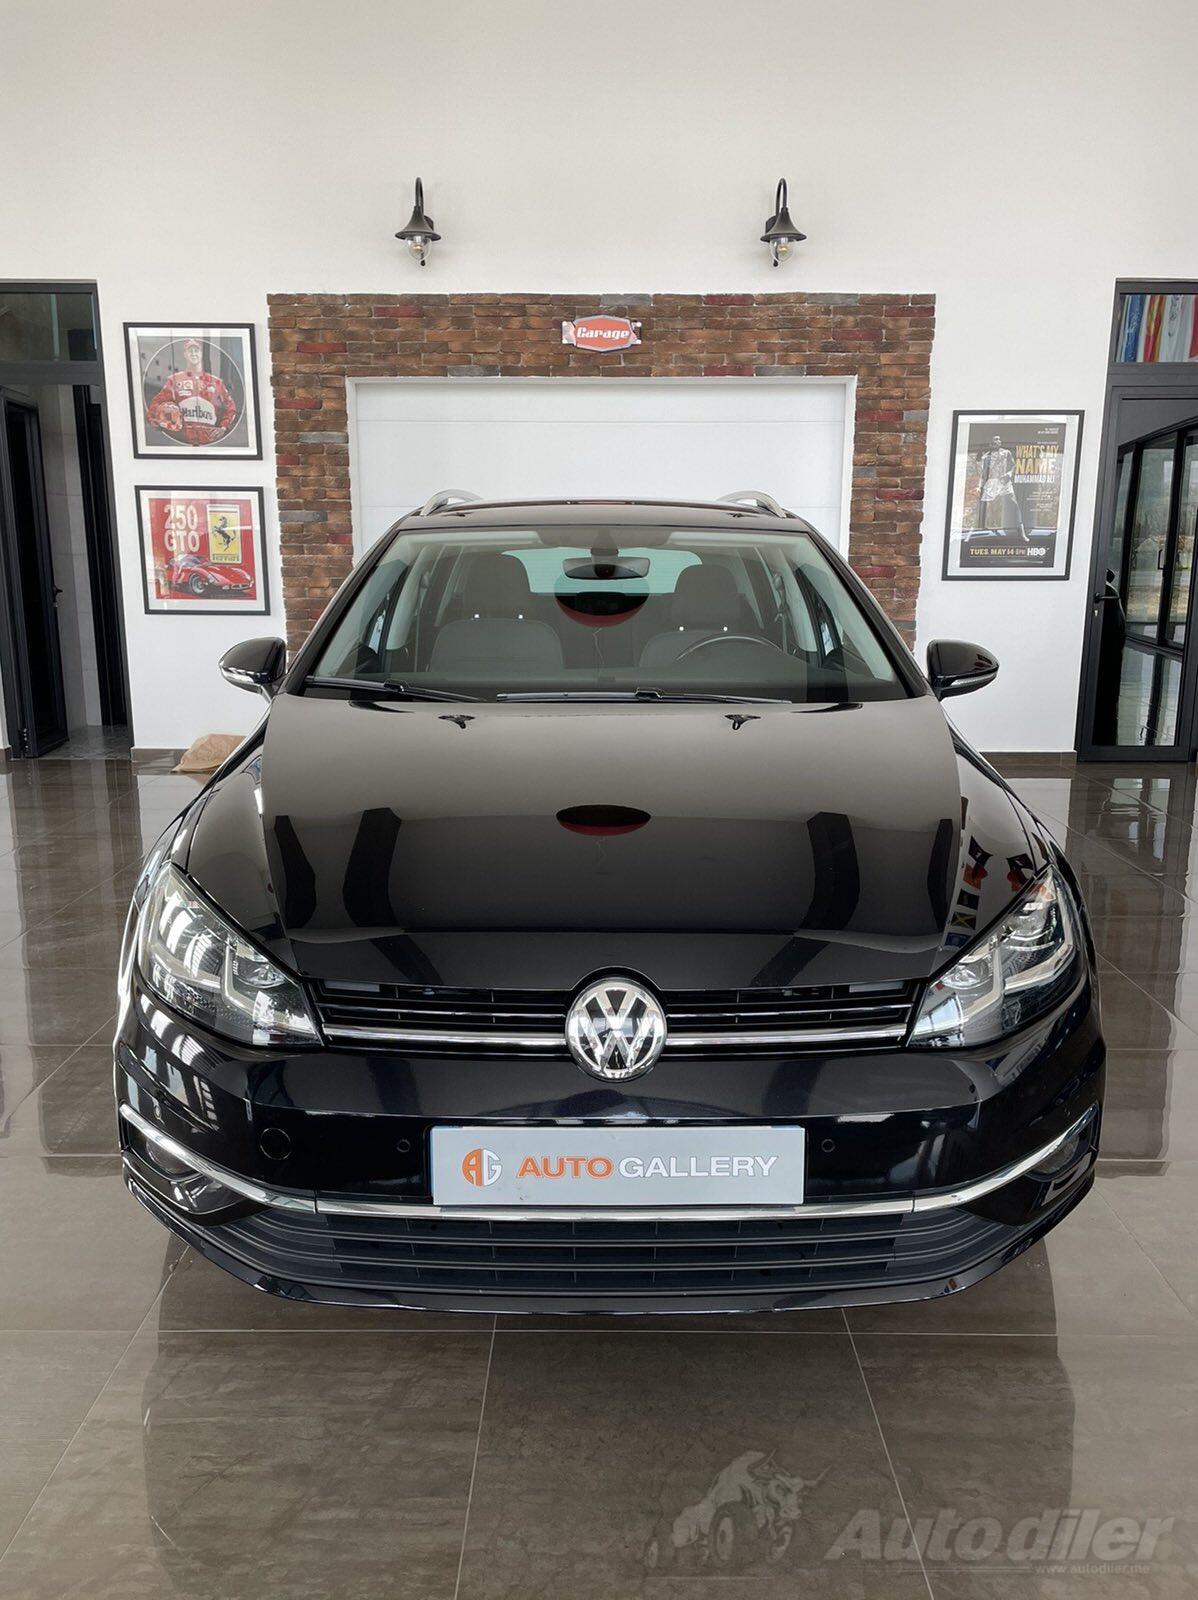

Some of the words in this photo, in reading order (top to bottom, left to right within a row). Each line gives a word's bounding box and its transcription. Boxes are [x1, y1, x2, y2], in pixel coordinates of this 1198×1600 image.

[577, 326, 630, 340] Garage
[1015, 458, 1057, 475] NAME
[163, 503, 198, 530] 250
[164, 530, 200, 553] GTO
[1026, 547, 1046, 556] HBO
[517, 1155, 613, 1180] AUTO
[617, 1155, 779, 1180] GALLERY
